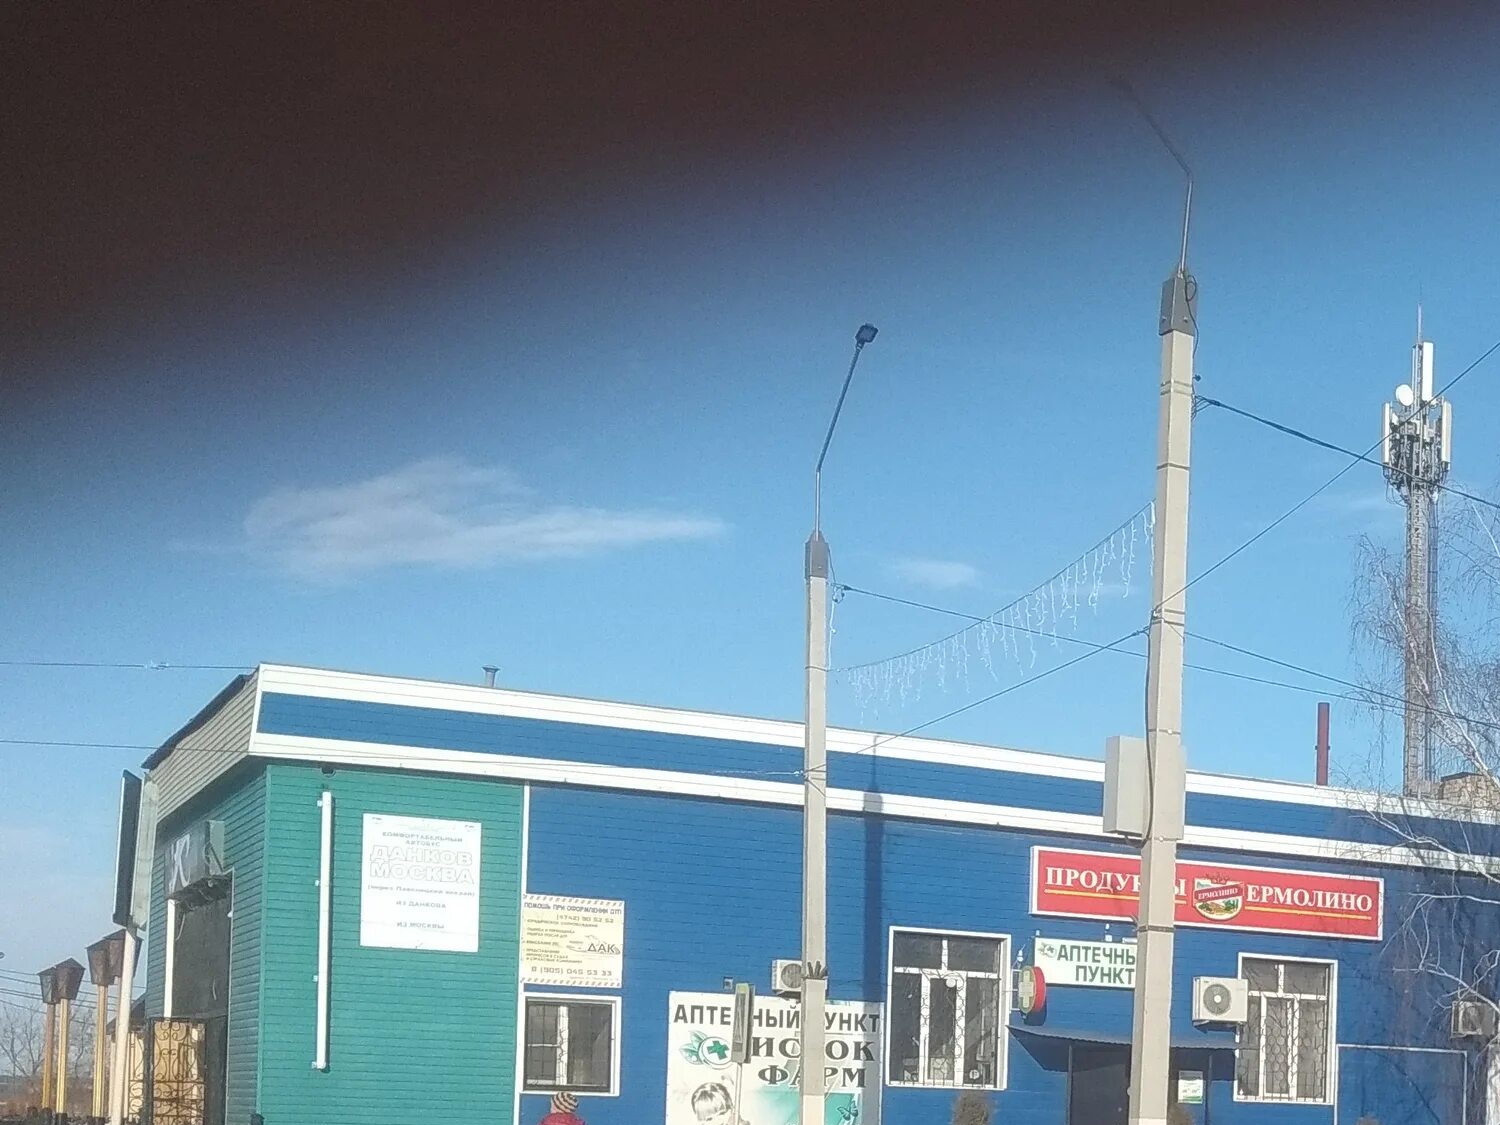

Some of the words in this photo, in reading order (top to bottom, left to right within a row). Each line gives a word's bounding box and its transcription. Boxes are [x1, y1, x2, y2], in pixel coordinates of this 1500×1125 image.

[370, 845, 473, 866] ДАНКОВ
[370, 862, 475, 885] МОСКВА
[1247, 884, 1373, 912] ЕРМОЛИНО
[587, 943, 615, 953] ДАК
[1076, 965, 1135, 985] ПУНКТ
[674, 1004, 800, 1029] АПТЕНЫЙ
[825, 1012, 880, 1033] УНКТ
[752, 1036, 875, 1062] ИСОК
